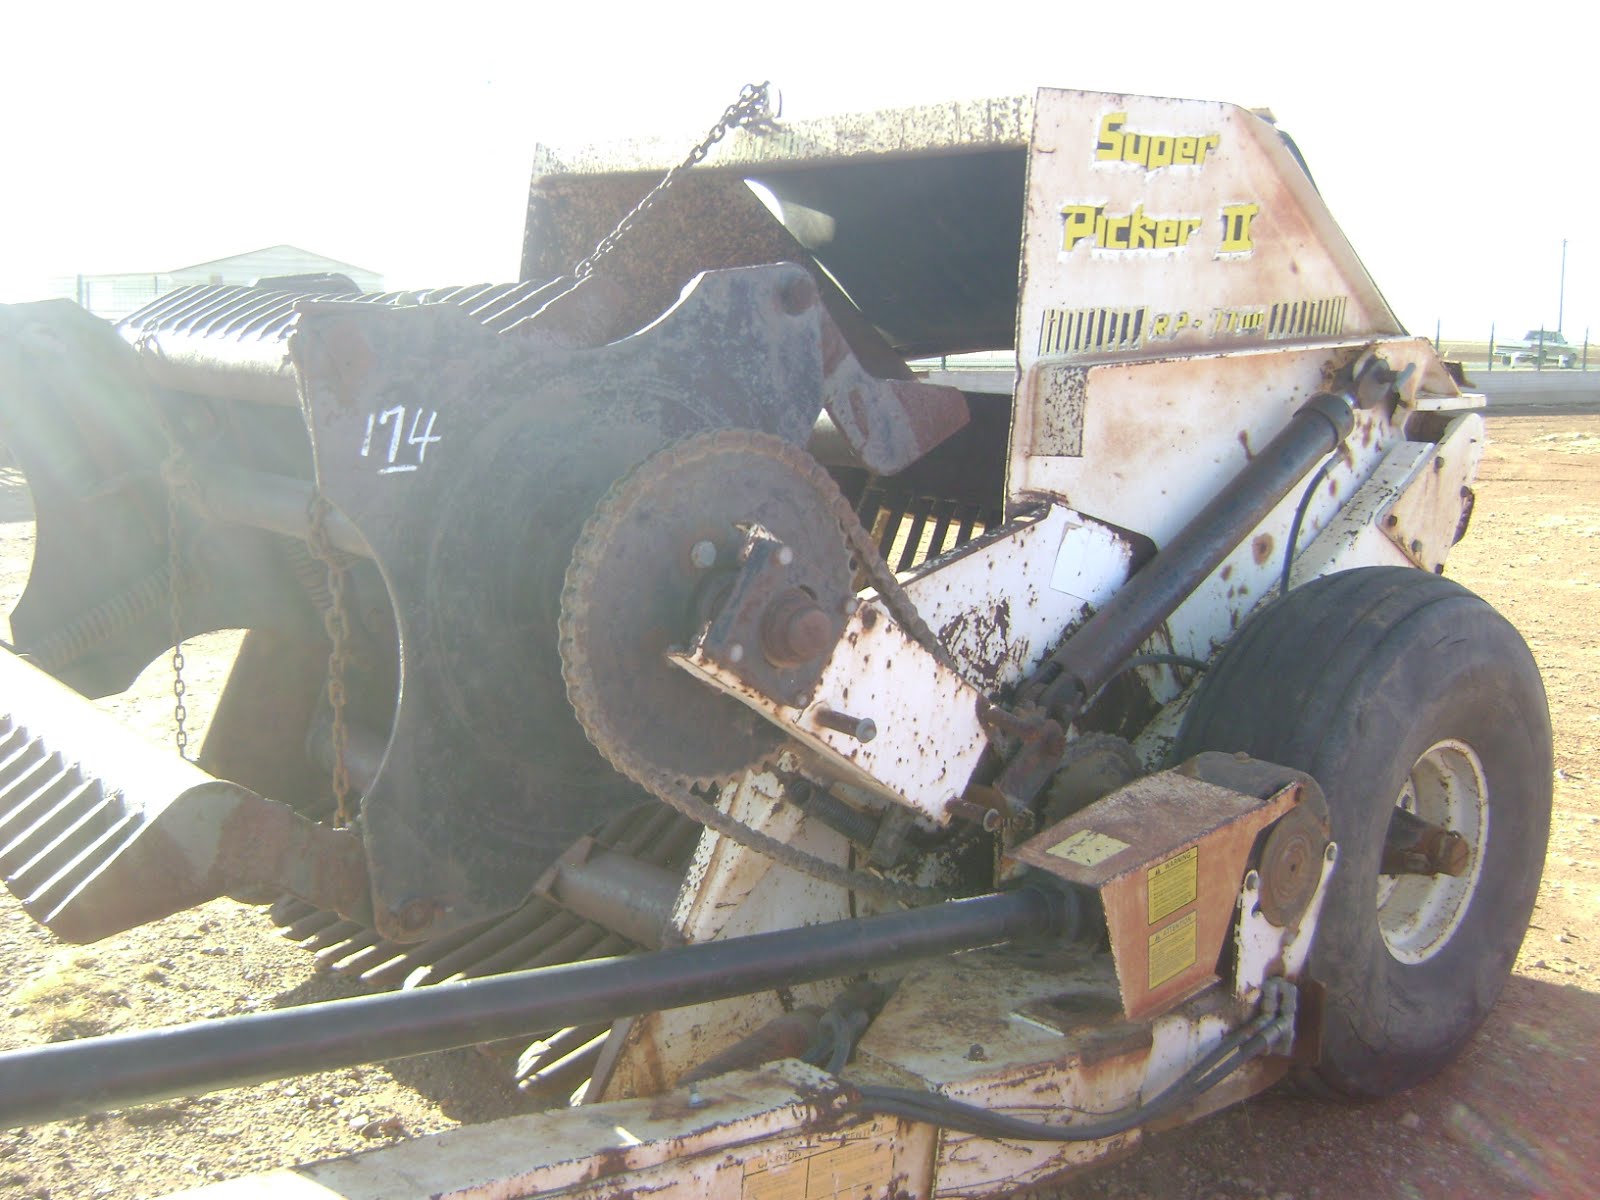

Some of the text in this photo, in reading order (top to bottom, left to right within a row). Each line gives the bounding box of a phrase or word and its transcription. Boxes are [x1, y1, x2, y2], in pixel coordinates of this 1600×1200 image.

[1096, 112, 1220, 171] Super
[1061, 203, 1259, 252] Picker II
[361, 405, 441, 463] 174
[1164, 852, 1191, 869] WARNING
[1163, 917, 1192, 937] ATTENTION
